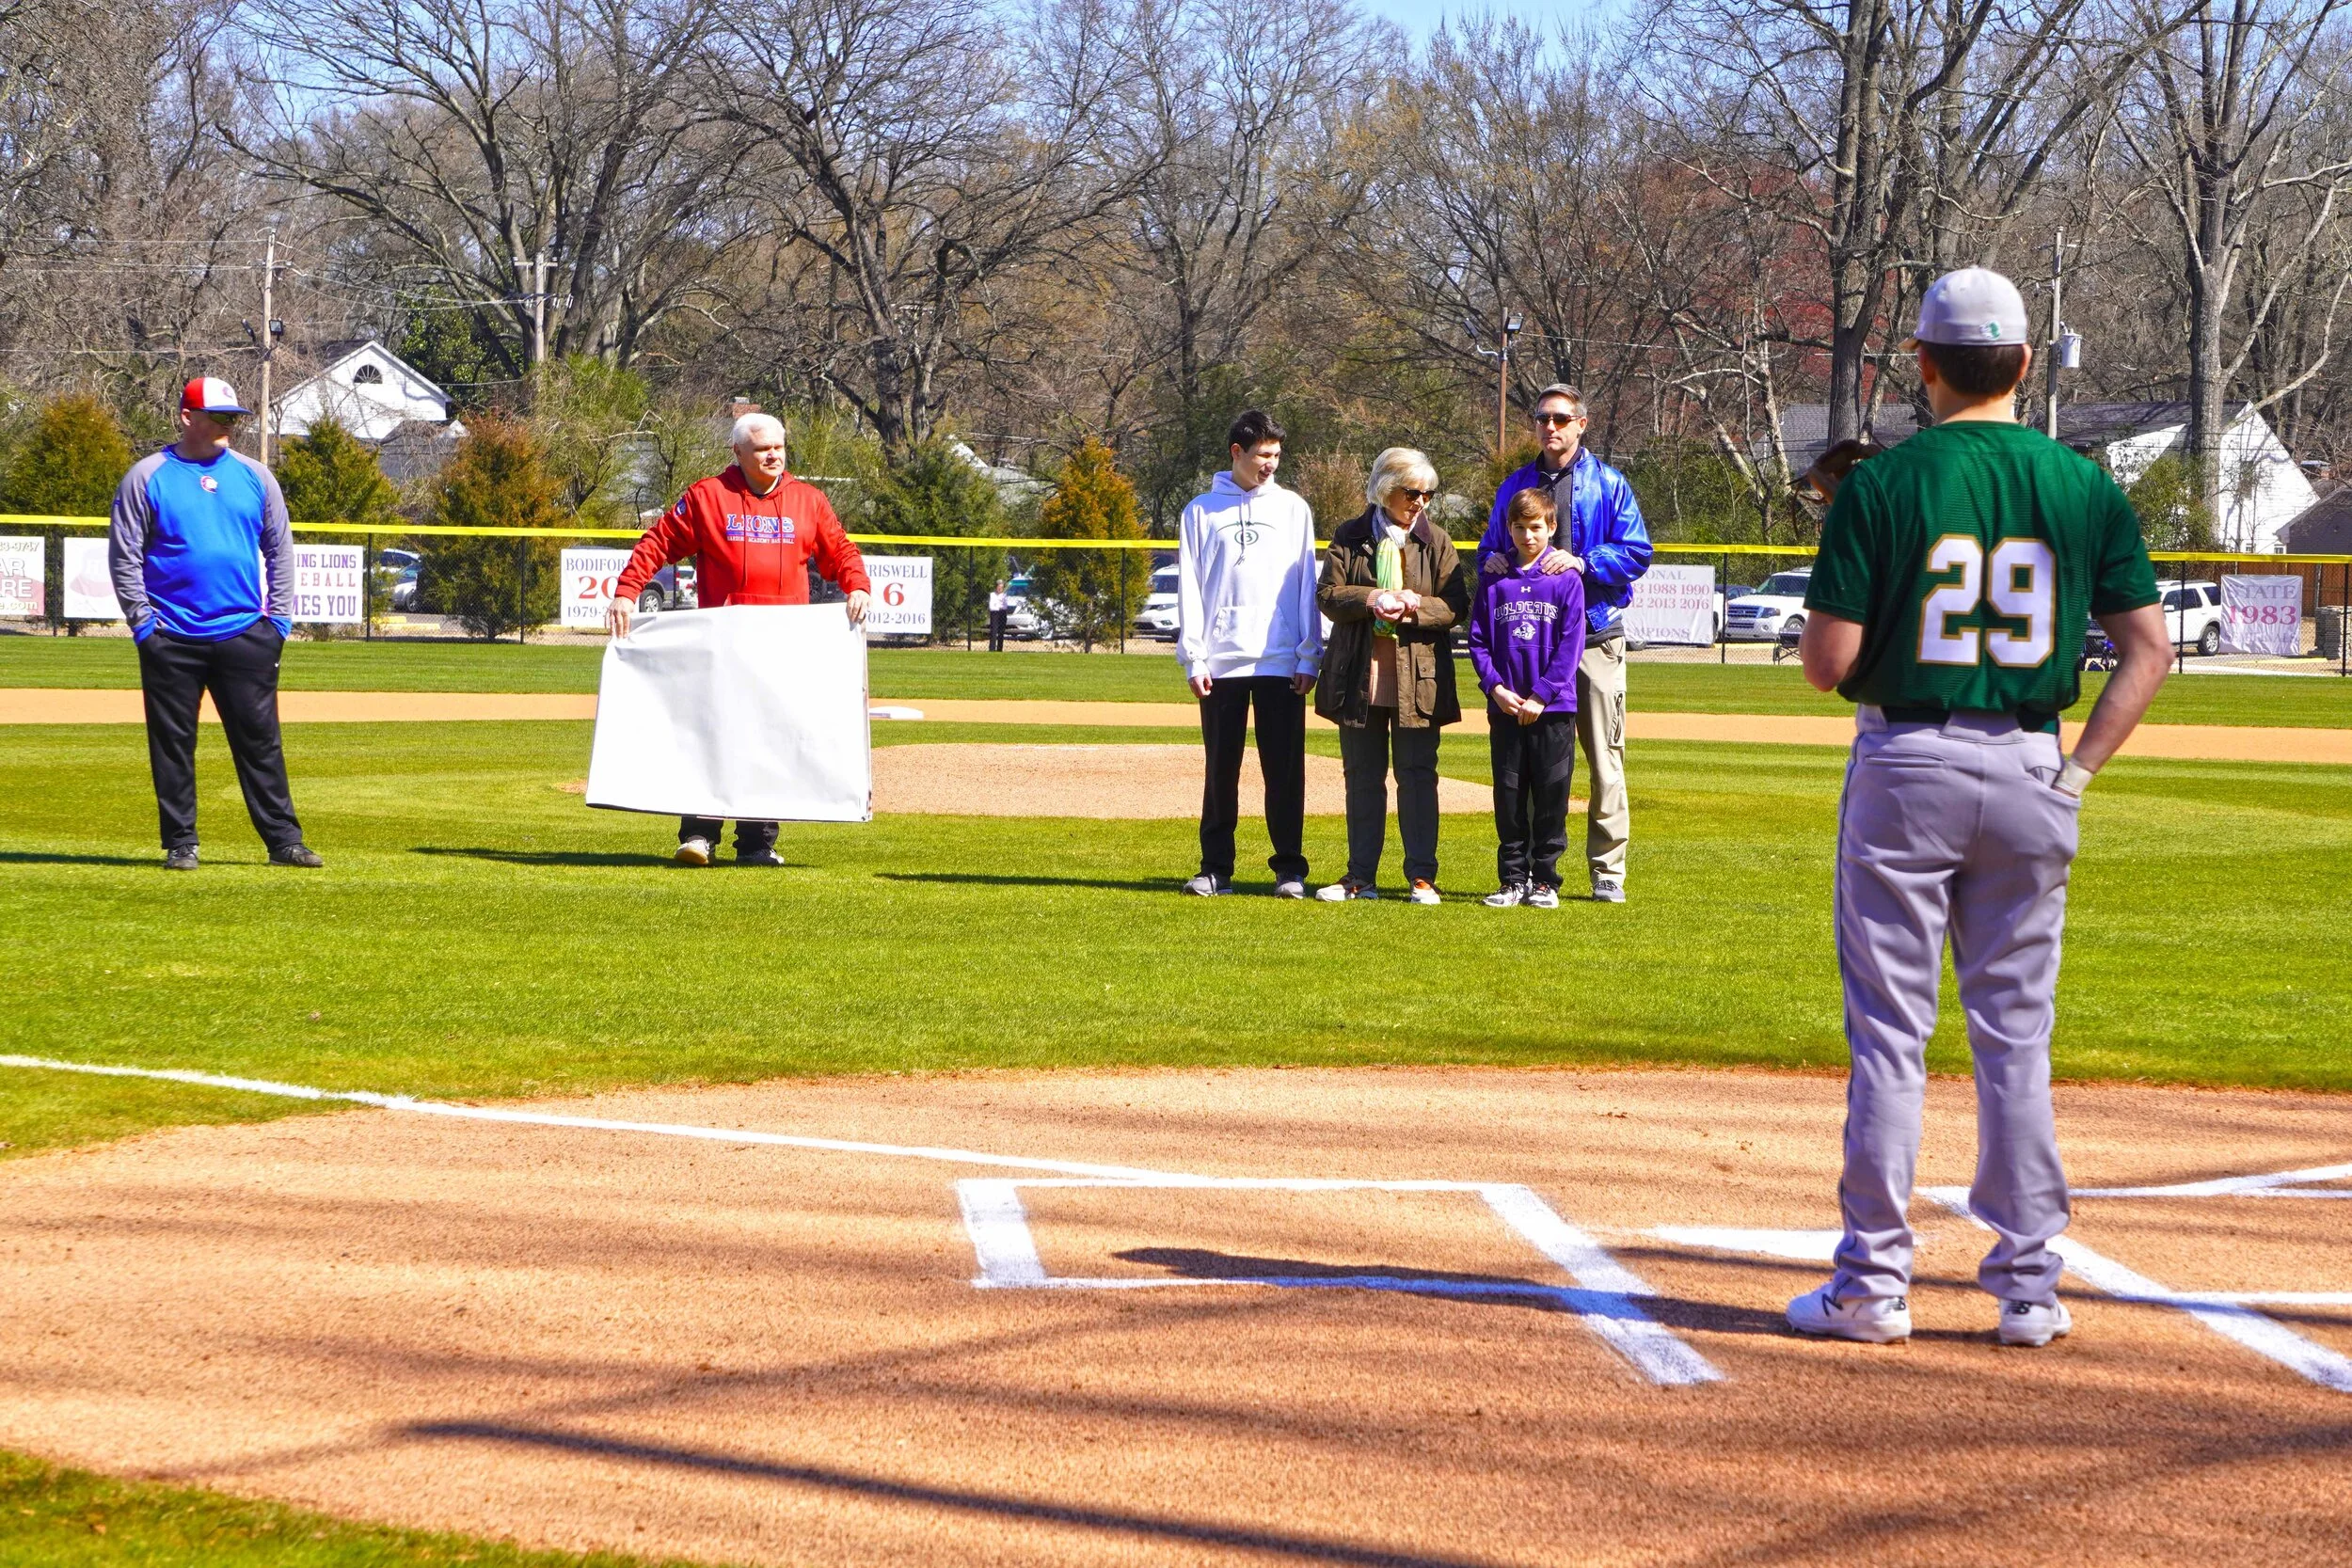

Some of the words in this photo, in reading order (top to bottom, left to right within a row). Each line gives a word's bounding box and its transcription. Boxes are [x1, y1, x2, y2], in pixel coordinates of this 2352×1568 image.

[726, 515, 794, 533] LIONS
[296, 553, 317, 568] ING
[321, 554, 357, 569] LIONS
[566, 558, 630, 572] BODIFOR
[865, 563, 928, 578] RISWELL
[1642, 569, 1687, 580] ONAL
[0, 578, 34, 598] RE
[300, 572, 357, 588] EBALL
[882, 582, 905, 607] 6
[1647, 583, 1677, 595] 1988
[1680, 584, 1710, 595] 1990
[326, 594, 357, 616] YOU
[1646, 597, 1677, 609] 2013
[1679, 598, 1710, 610] 2016
[1916, 533, 2057, 668] 29
[866, 611, 927, 625] 012-2016
[1493, 600, 1559, 621] WILDCATS
[2228, 605, 2297, 626] 1983
